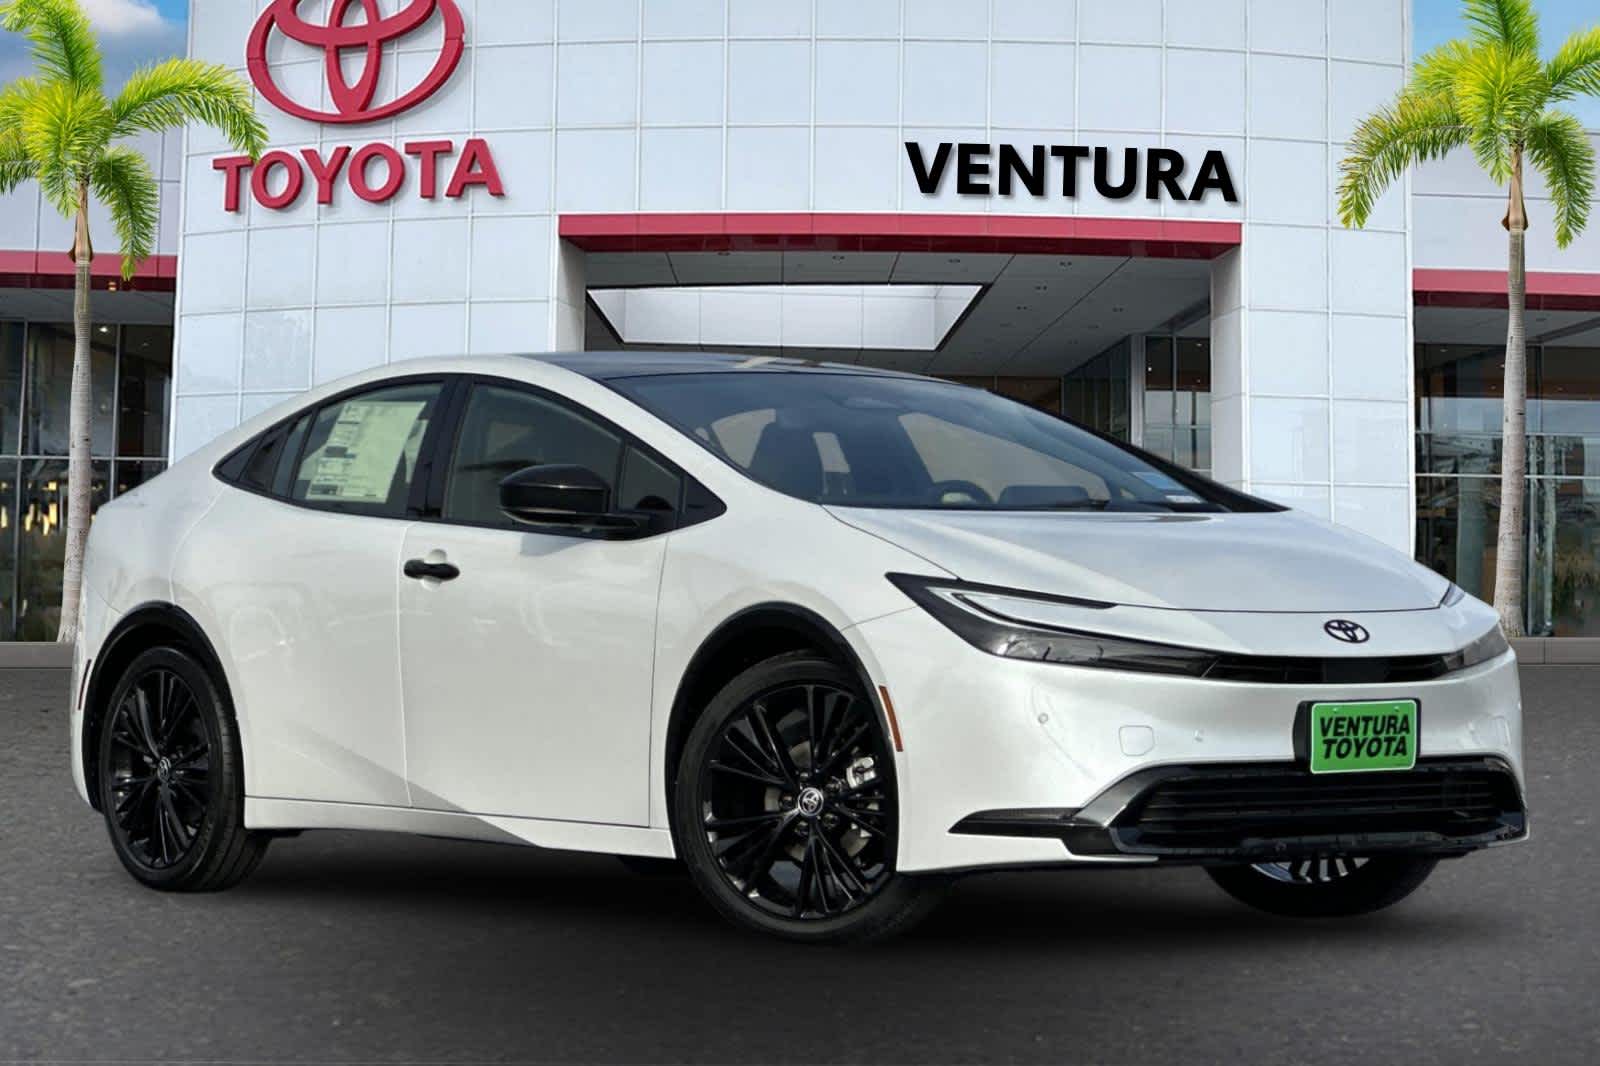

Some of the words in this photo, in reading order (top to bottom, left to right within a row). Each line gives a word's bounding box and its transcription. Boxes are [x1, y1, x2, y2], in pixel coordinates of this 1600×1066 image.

[212, 138, 505, 212] TOYOTA
[905, 141, 1238, 202] VENTURA
[1320, 714, 1410, 737] VENTURA
[1322, 736, 1408, 759] TOYOTA
